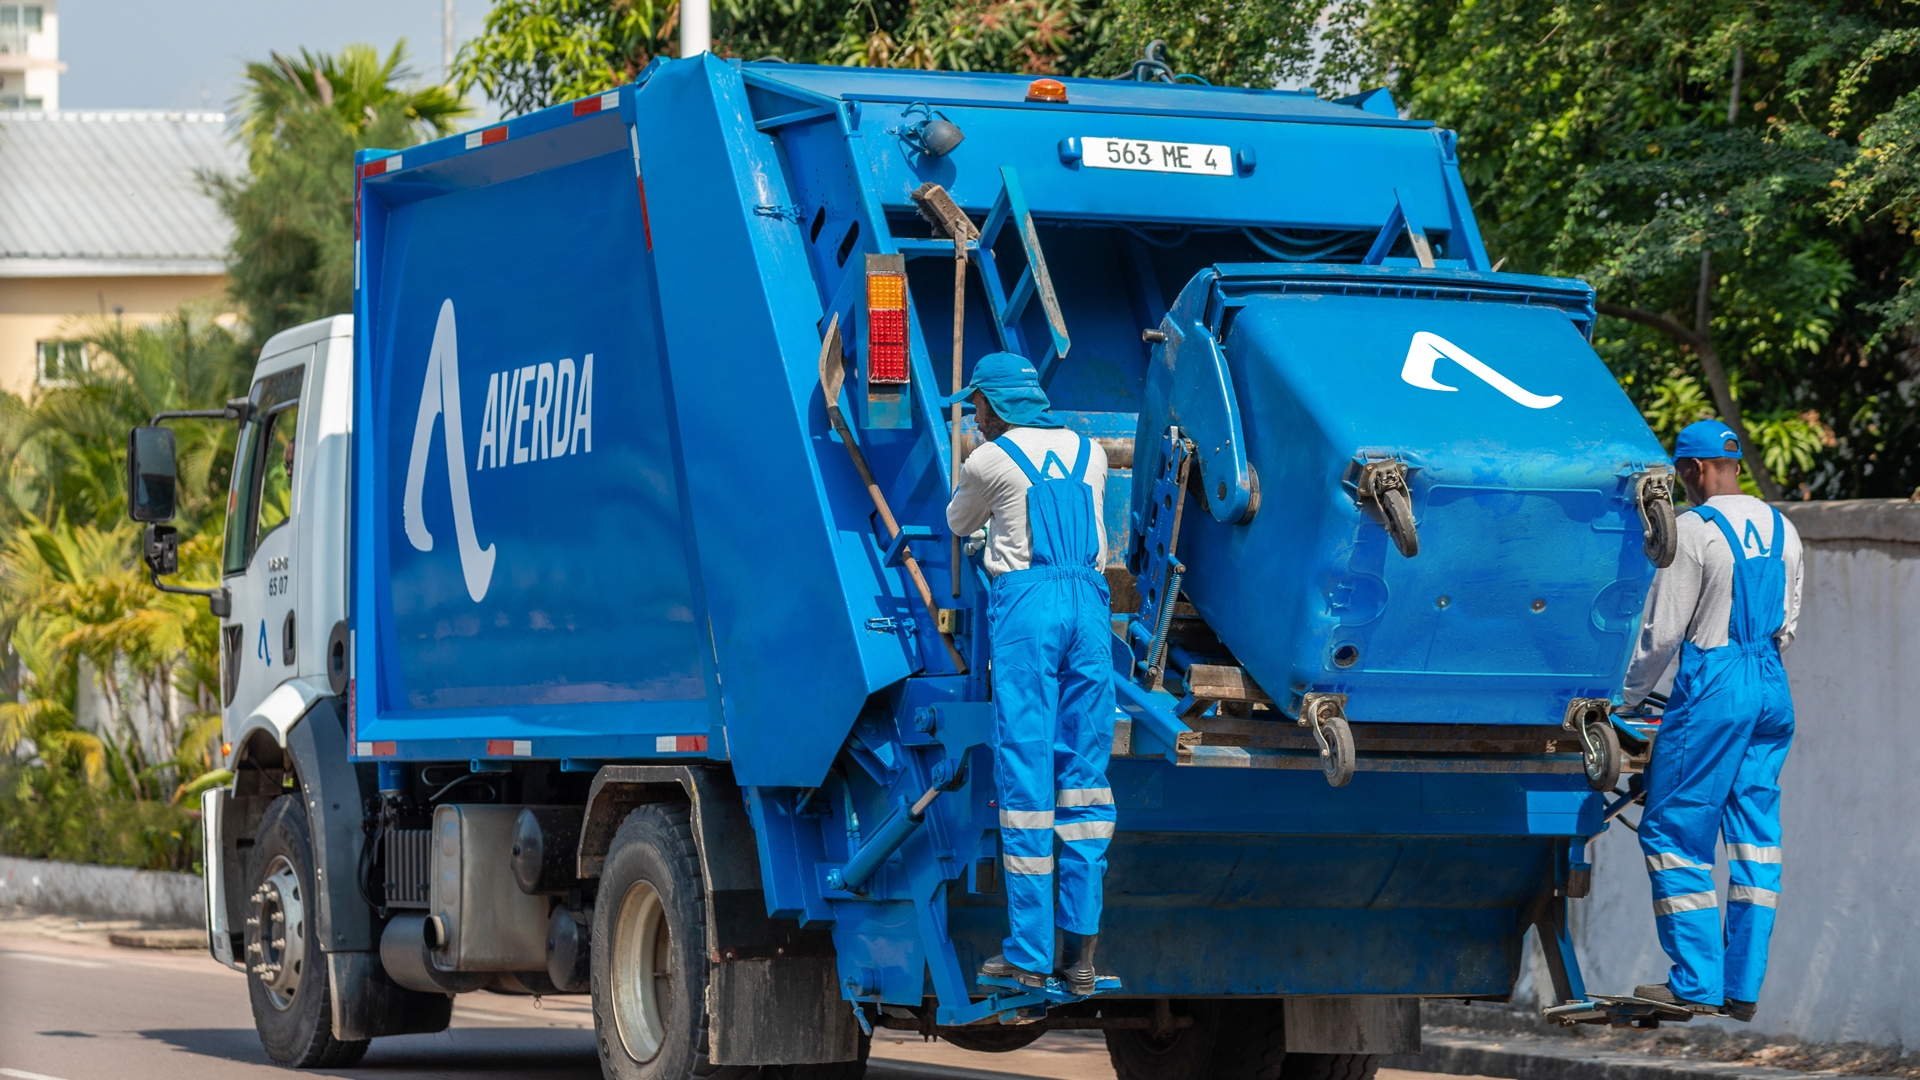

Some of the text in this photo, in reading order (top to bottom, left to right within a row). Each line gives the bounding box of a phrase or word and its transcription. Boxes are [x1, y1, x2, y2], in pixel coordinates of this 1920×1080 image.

[1106, 141, 1217, 170] 563 ME 4
[477, 353, 593, 471] AVERDA
